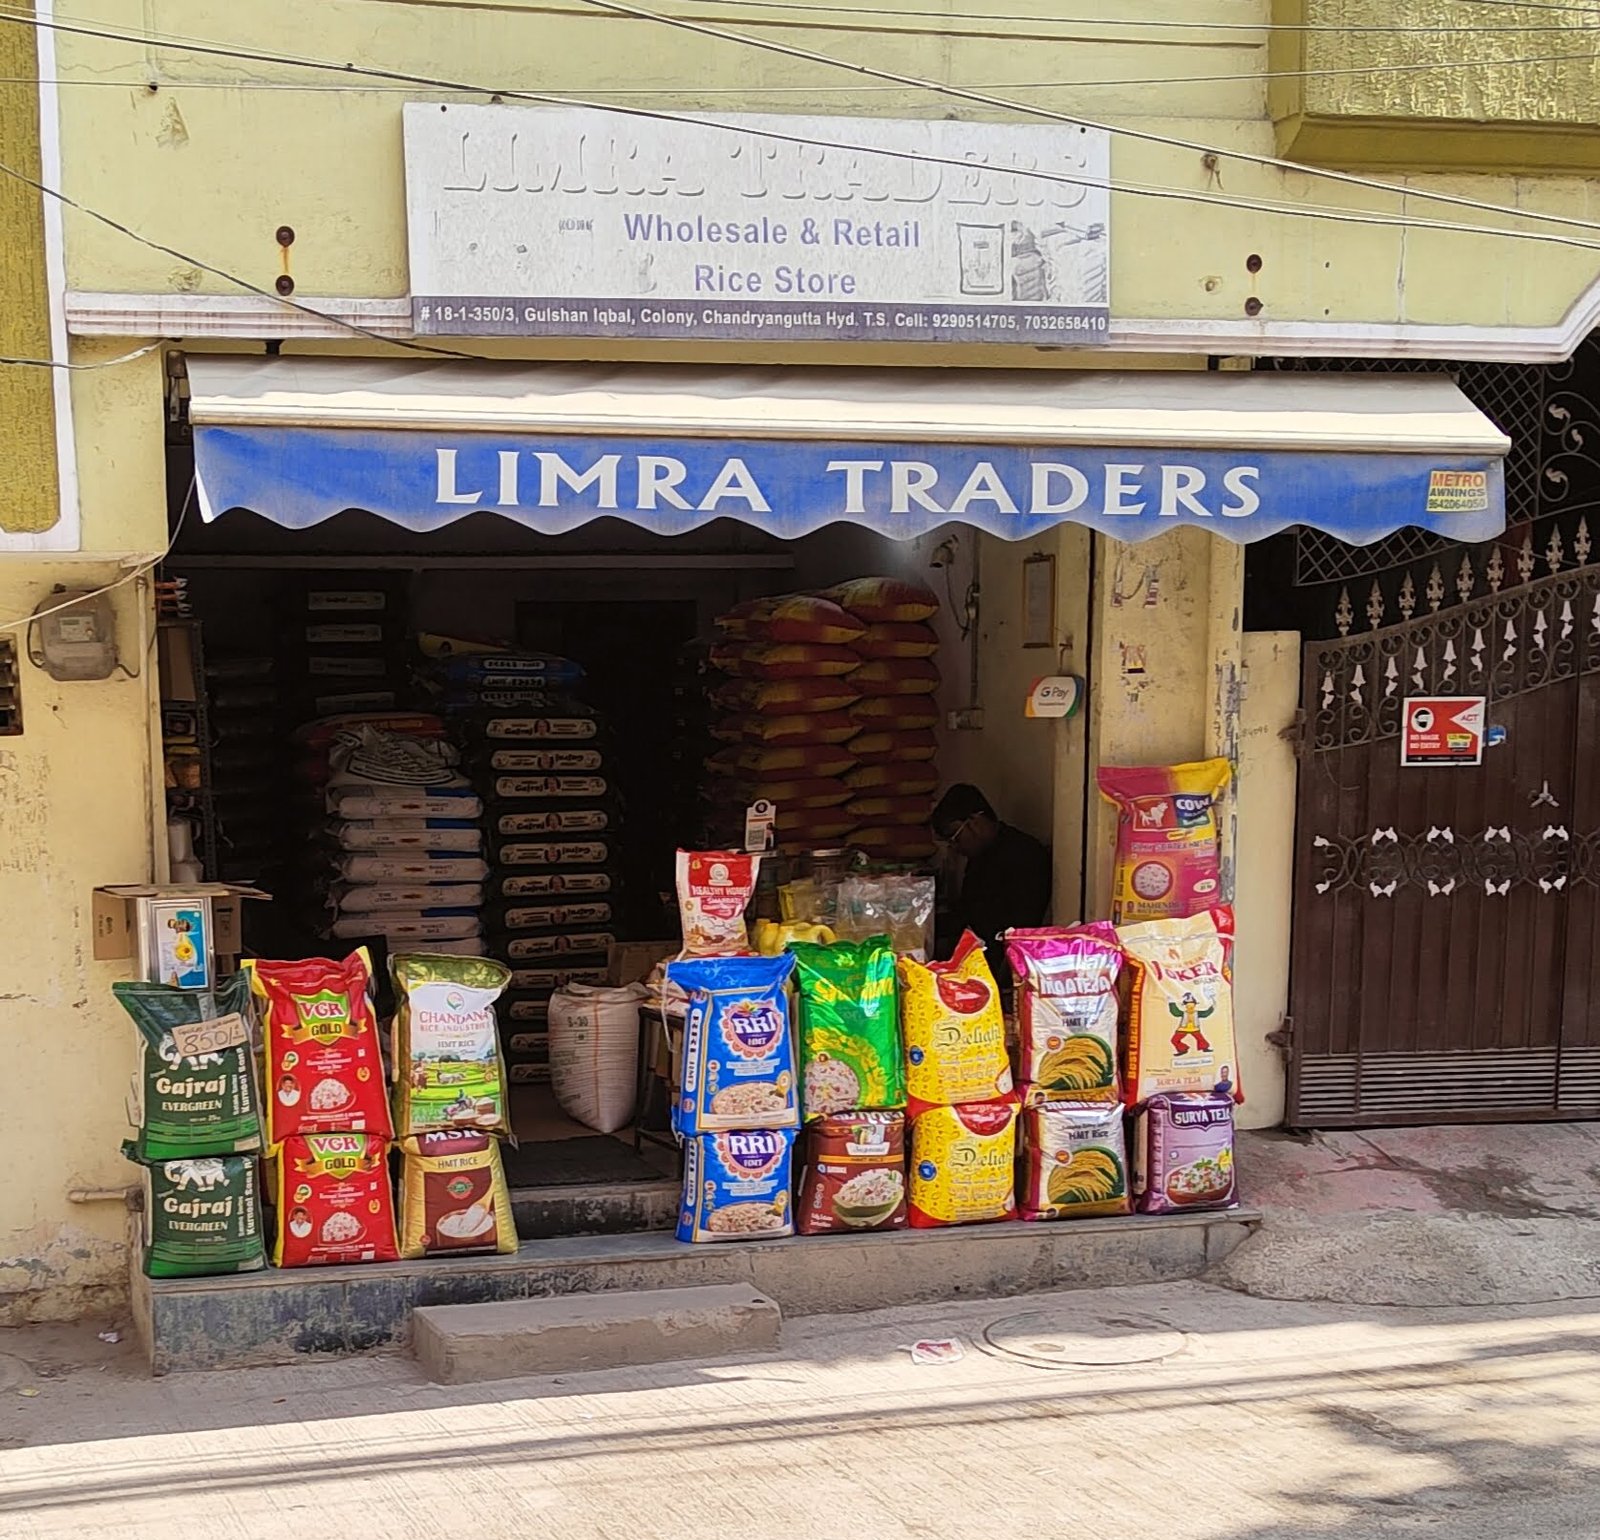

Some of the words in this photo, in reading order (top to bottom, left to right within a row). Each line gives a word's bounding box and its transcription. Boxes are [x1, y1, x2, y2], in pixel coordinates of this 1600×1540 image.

[624, 213, 788, 244] Wholesale
[800, 217, 820, 245] &
[834, 219, 920, 247] Retail
[694, 264, 762, 293] Rice
[774, 265, 856, 294] Store
[420, 307, 430, 320] #
[434, 307, 519, 324] 18-1-350/3,
[524, 307, 588, 322] Gulshan
[593, 309, 635, 326] Iqbal,
[641, 309, 698, 326] Colony,
[703, 309, 822, 330] Chandryangutta
[895, 313, 928, 327] Cell:
[1024, 315, 1106, 331] 7032658410
[435, 449, 773, 513] LIMRA
[825, 460, 1262, 518] TRADERS
[1431, 473, 1484, 487] METRO
[1429, 488, 1486, 497] AWNINGS
[299, 1001, 346, 1019] VGR
[311, 1023, 342, 1036] GOLD
[731, 1010, 777, 1034] RRI
[156, 1074, 227, 1099] Gajraj
[161, 1099, 223, 1112] EVERGREEN
[1174, 1109, 1209, 1124] SURYA
[312, 1136, 359, 1153] VGR
[729, 1135, 775, 1155] RRI
[325, 1158, 356, 1170] GOLD
[438, 1160, 457, 1169] HMT
[459, 1157, 478, 1167] RICE
[163, 1196, 233, 1219] Gajraj
[168, 1220, 229, 1232] EVERGREEN
